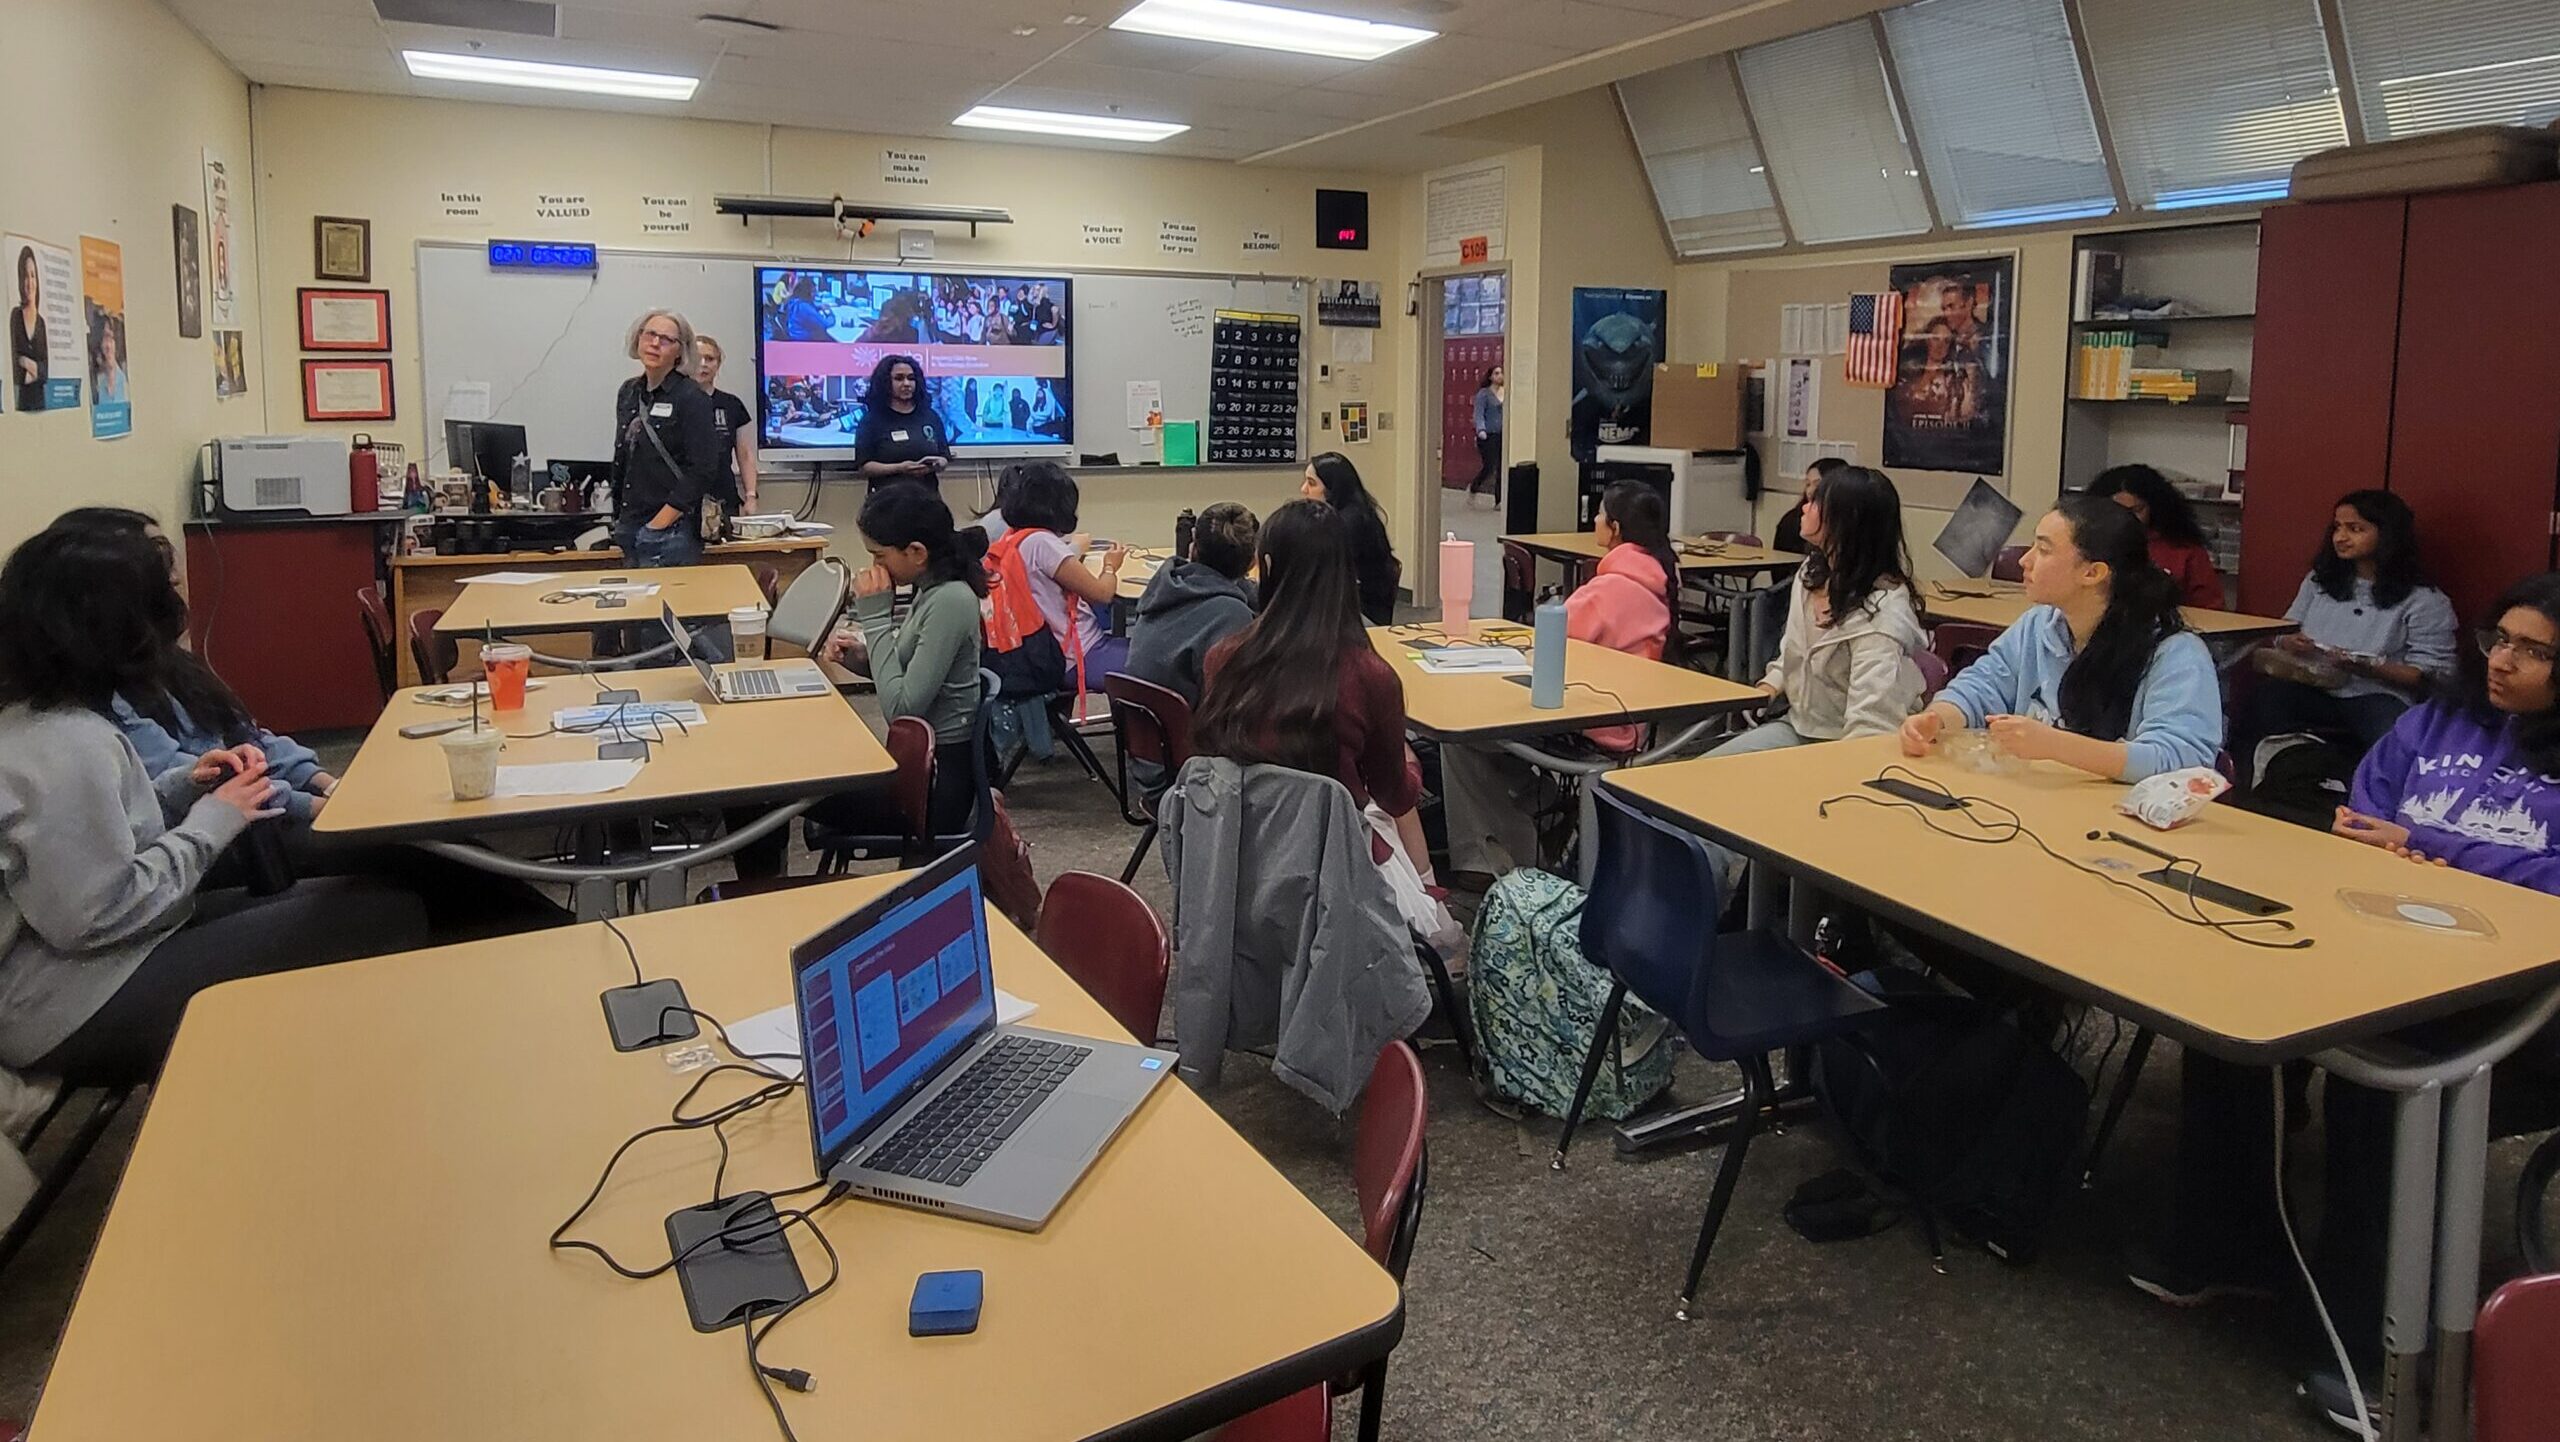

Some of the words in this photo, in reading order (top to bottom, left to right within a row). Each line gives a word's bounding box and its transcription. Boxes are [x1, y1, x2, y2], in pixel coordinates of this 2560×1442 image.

[886, 150, 906, 160] You
[908, 153, 926, 161] can
[892, 164, 920, 172] make
[884, 175, 929, 185] mistakes
[440, 192, 454, 202] In
[457, 193, 482, 203] this
[539, 195, 563, 205] You
[566, 196, 585, 204] are
[642, 196, 665, 206] You
[446, 207, 479, 216] room
[536, 208, 591, 218] VALUED
[659, 210, 672, 218] be
[642, 222, 690, 232] yourself
[1082, 224, 1101, 233] You
[1102, 225, 1123, 233] have
[1162, 222, 1180, 231] You
[1181, 224, 1196, 232] can
[1092, 236, 1122, 244] VOICE
[1160, 233, 1197, 243] advocate
[1253, 231, 1270, 240] You
[1162, 244, 1177, 252] for
[1178, 245, 1194, 254] you
[1242, 242, 1280, 251] BELONG!
[1461, 242, 1487, 259] C109
[1220, 330, 1227, 340] 1
[1234, 331, 1243, 341] 2
[1250, 332, 1258, 342] 3
[1276, 333, 1284, 343] 5
[1289, 334, 1297, 344] 6
[1219, 354, 1227, 364] 7
[1234, 355, 1242, 365] 8
[1249, 356, 1258, 365] 9
[1275, 358, 1284, 367] 11
[1288, 358, 1298, 367] 12
[1216, 377, 1227, 387] 13
[1231, 379, 1242, 388] 14
[1246, 380, 1258, 389] 15
[1273, 381, 1284, 390] 17
[1216, 403, 1227, 412] 19
[1228, 402, 1242, 413] 20
[1244, 403, 1256, 413] 21
[1271, 404, 1284, 414] 23
[1284, 404, 1297, 414] 24
[1212, 426, 1225, 436] 25
[1226, 426, 1240, 436] 26
[1242, 426, 1255, 436] 27
[1212, 450, 1223, 460] 31
[1225, 449, 1238, 459] 32
[1240, 448, 1253, 459] 33
[1254, 448, 1267, 459] 34
[1268, 448, 1282, 459] 35
